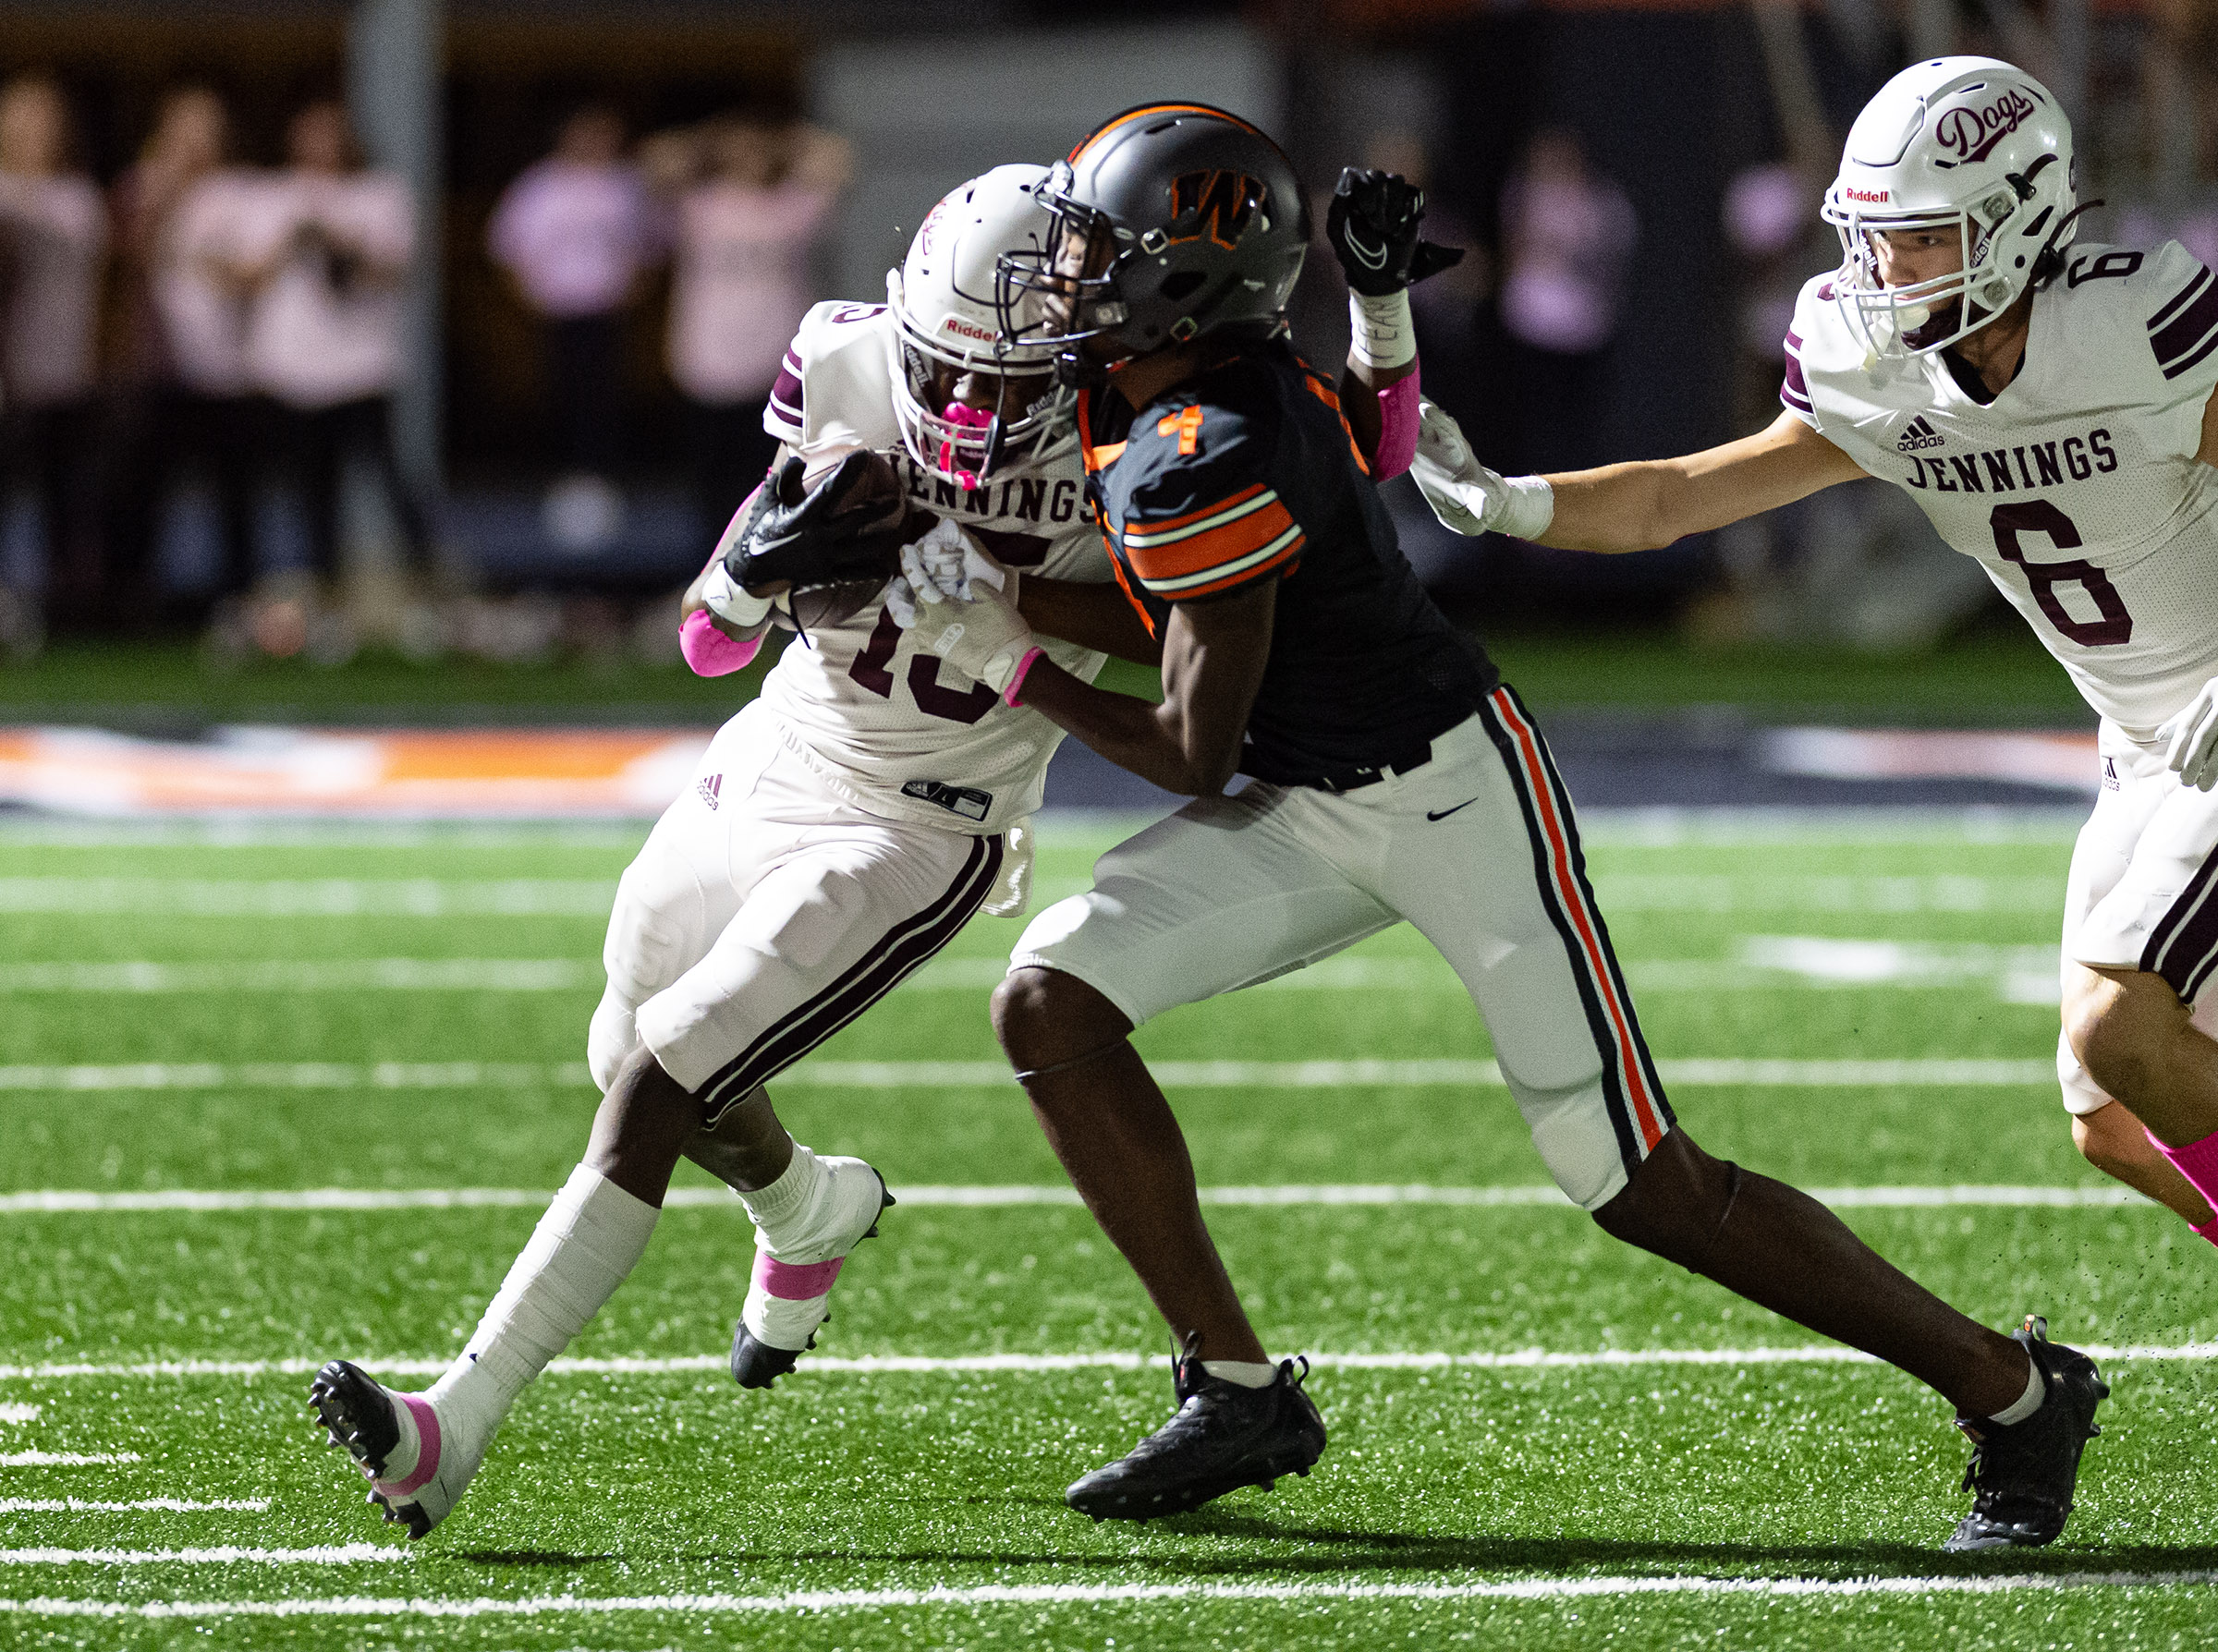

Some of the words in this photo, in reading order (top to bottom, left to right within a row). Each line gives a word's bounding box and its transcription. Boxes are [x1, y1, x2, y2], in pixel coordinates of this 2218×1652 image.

[1936, 89, 2035, 157] Dogs
[1846, 188, 1888, 202] Riddell
[947, 320, 1003, 343] Riddel
[1897, 435, 1944, 451] adidas
[1906, 429, 2118, 492] JENNINGS
[1990, 499, 2133, 647] 6
